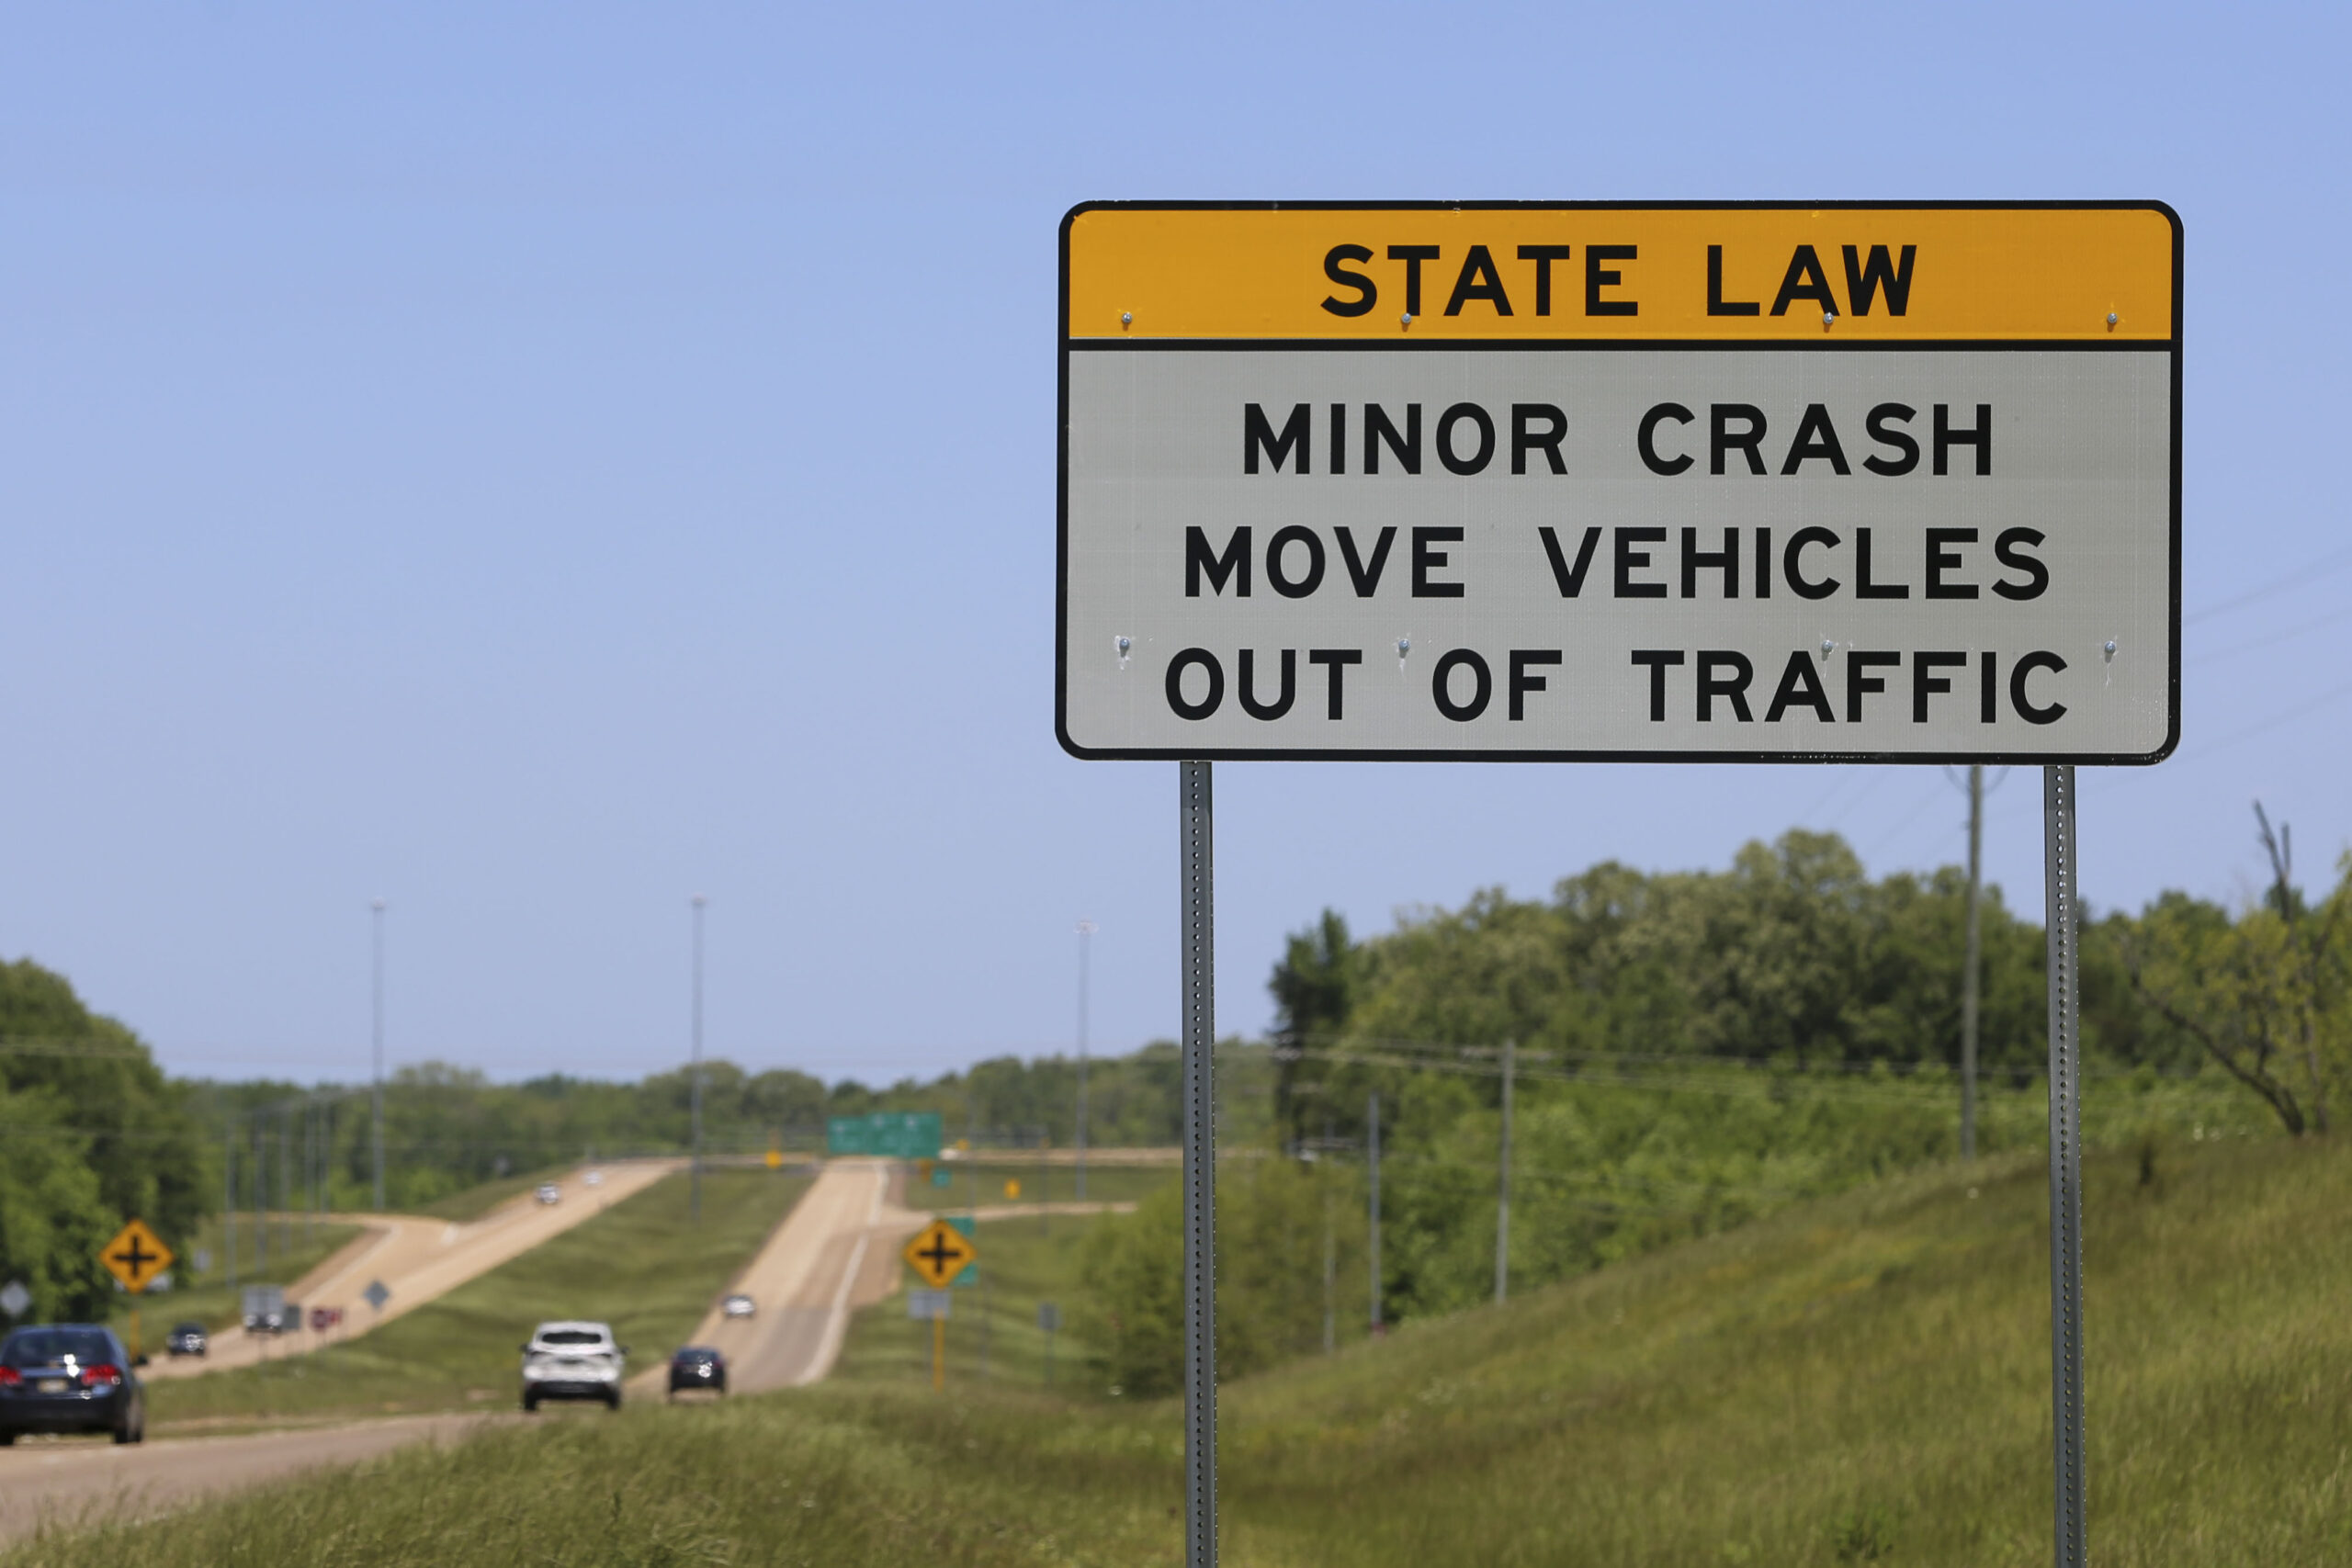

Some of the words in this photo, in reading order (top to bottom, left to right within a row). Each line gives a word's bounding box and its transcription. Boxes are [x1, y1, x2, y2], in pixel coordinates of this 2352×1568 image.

[1321, 244, 1637, 316] STATE
[1707, 245, 1917, 316] LAW
[1244, 403, 1567, 476] MINOR
[1638, 402, 1991, 477] CRASH
[1185, 525, 1464, 598] MOVE
[1538, 526, 2049, 601] VEHICLES
[1165, 648, 1362, 720] OUT
[1432, 649, 1562, 722] OF
[1632, 649, 2067, 725] TRAFFIC
